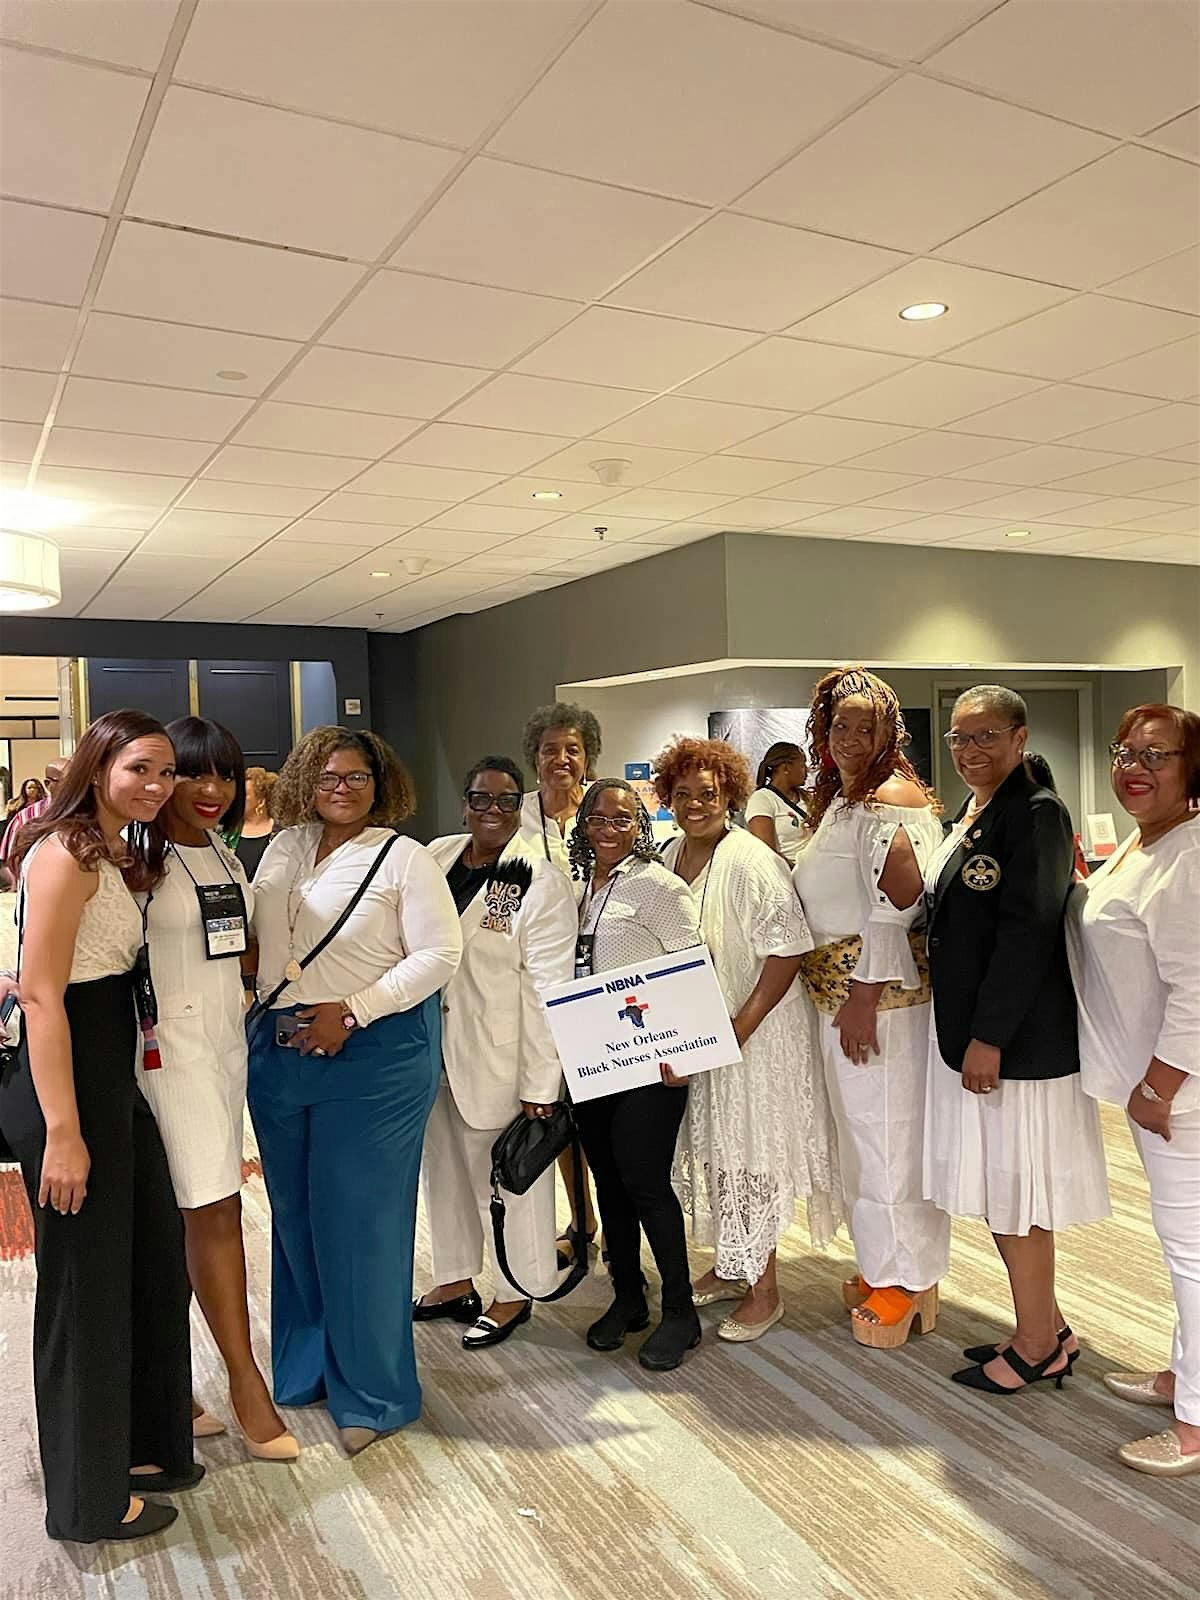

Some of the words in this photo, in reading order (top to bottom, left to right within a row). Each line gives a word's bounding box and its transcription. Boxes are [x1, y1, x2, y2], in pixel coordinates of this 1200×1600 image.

[605, 974, 645, 993] NBNA
[605, 1041, 631, 1054] New
[633, 1027, 679, 1046] Orleans
[577, 1061, 609, 1079] Black
[611, 1051, 651, 1069] Nurses
[654, 1034, 718, 1058] Association
